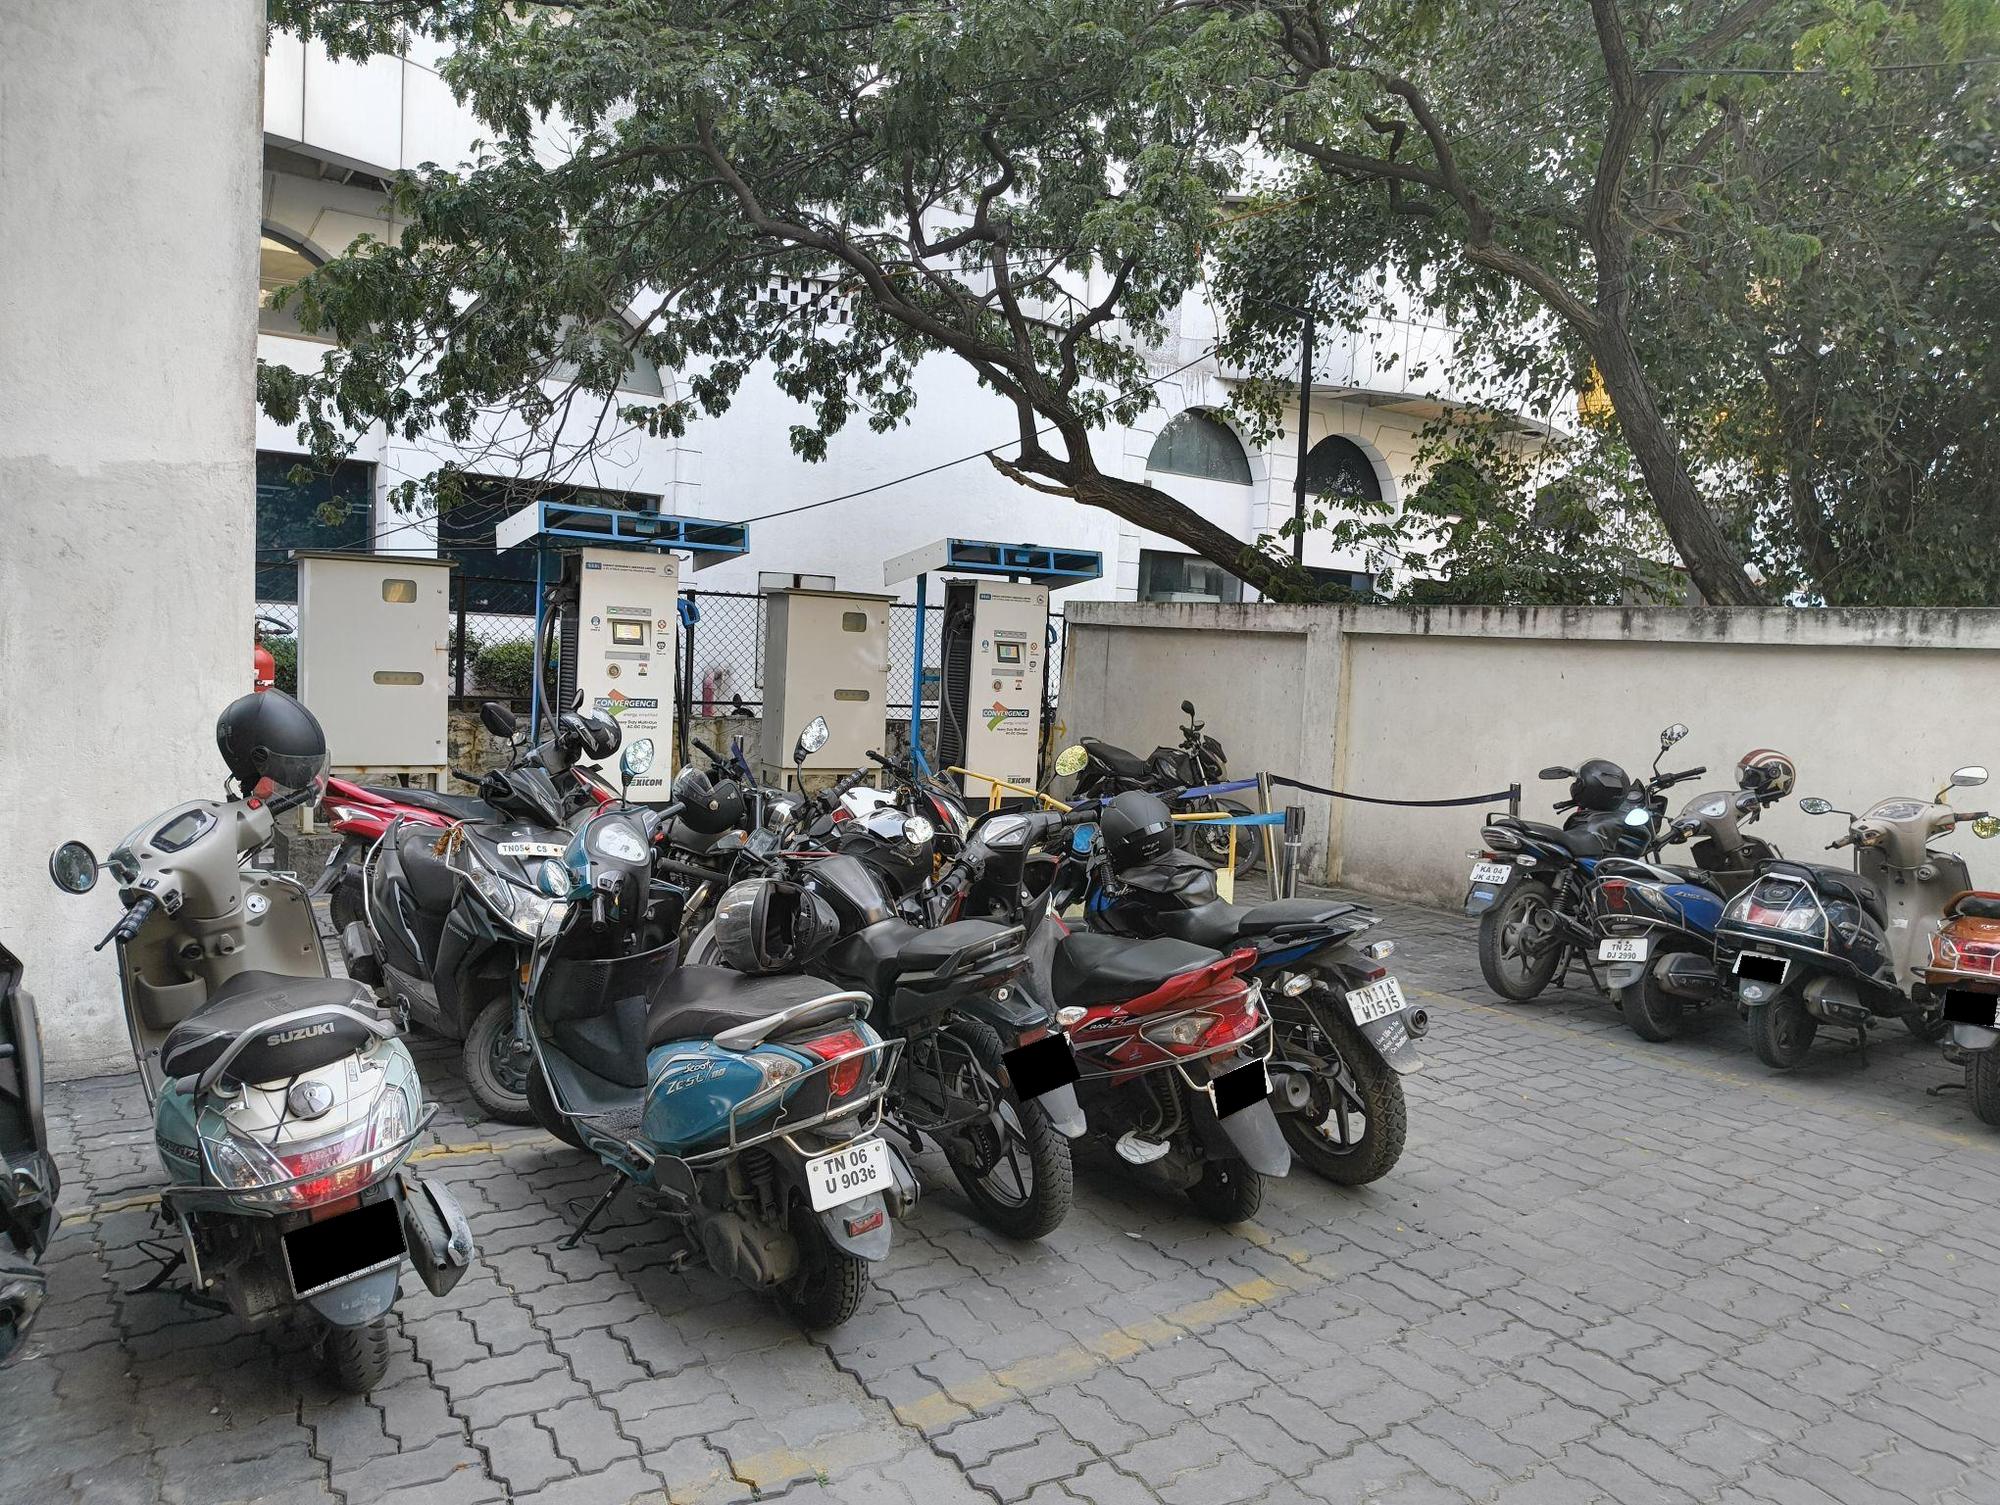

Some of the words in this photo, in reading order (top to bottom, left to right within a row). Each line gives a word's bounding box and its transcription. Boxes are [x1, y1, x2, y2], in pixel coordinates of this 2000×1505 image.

[267, 1022, 335, 1047] SUZUKI
[684, 1058, 716, 1080] Scooty
[666, 1074, 704, 1095] Zest
[824, 1155, 846, 1174] TN
[849, 1149, 868, 1167] 06
[825, 1178, 837, 1194] U
